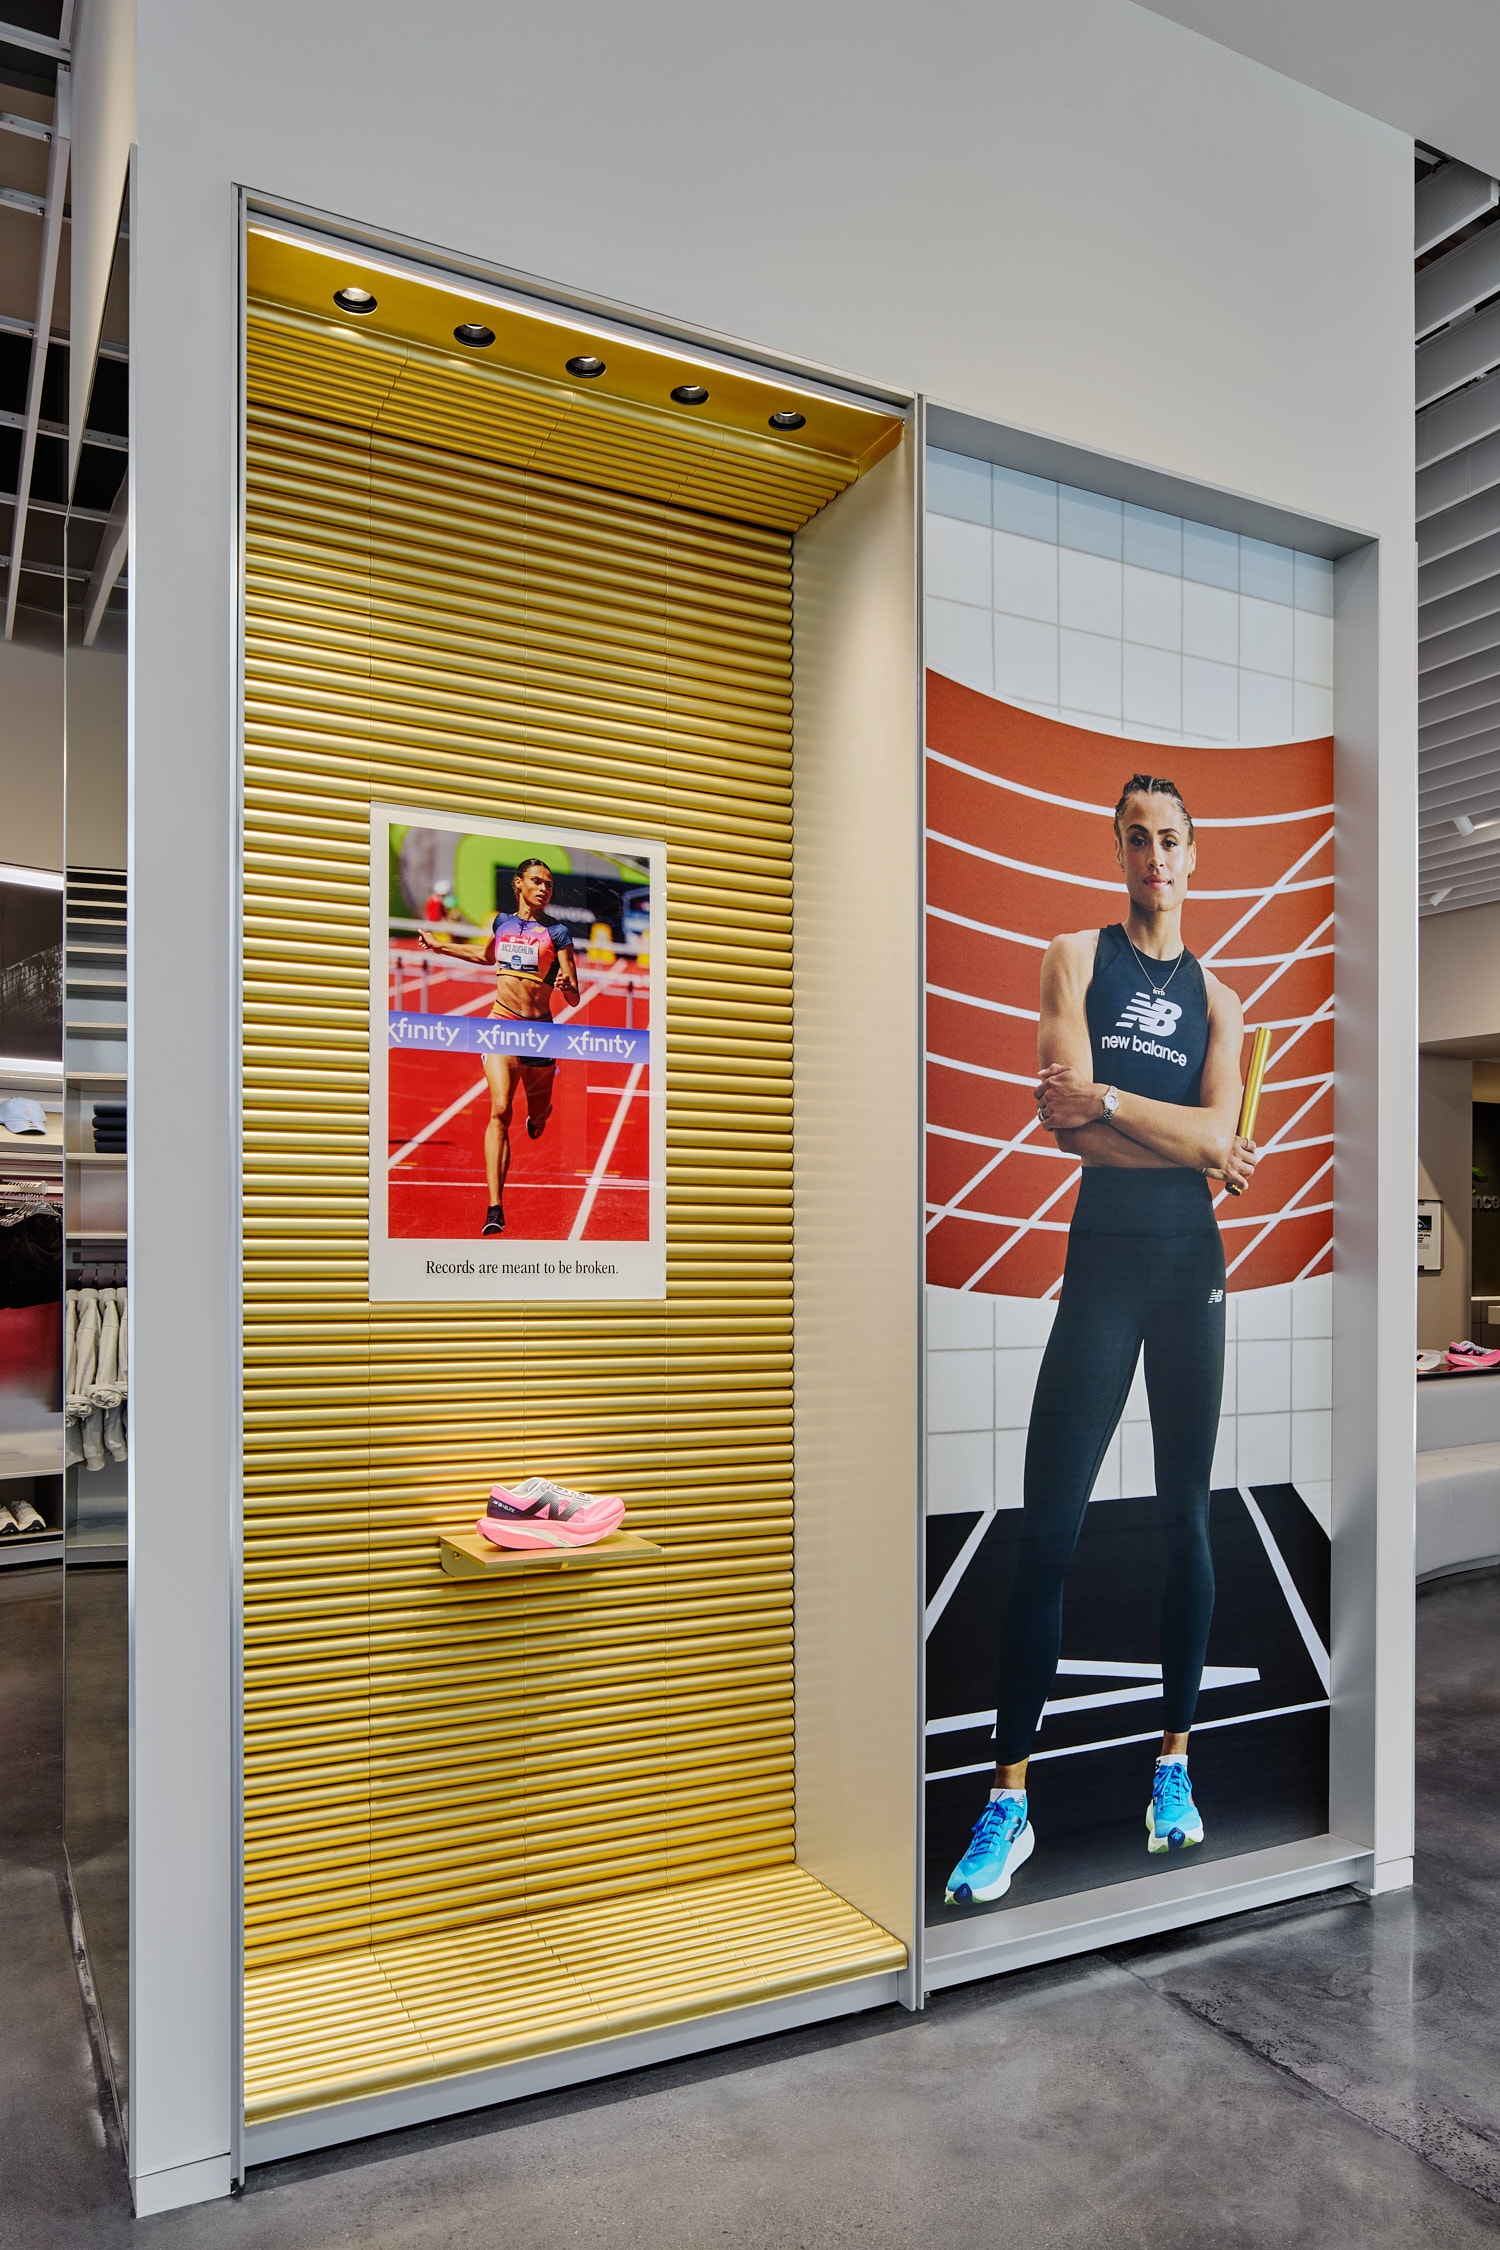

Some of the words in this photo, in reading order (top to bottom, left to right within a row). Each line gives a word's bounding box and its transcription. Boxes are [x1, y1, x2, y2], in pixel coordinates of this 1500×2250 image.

[502, 943, 534, 956] MCLAUGHLIN
[476, 1024, 550, 1053] xfinity
[567, 1031, 637, 1059] xfinity
[1101, 1035, 1131, 1049] new
[1132, 1035, 1188, 1067] balance
[1472, 1195, 1500, 1209] nce
[426, 1260, 475, 1274] Records
[479, 1263, 498, 1274] are
[502, 1261, 540, 1274] meant
[544, 1262, 555, 1274] to
[558, 1260, 572, 1274] be
[575, 1260, 619, 1274] broken.
